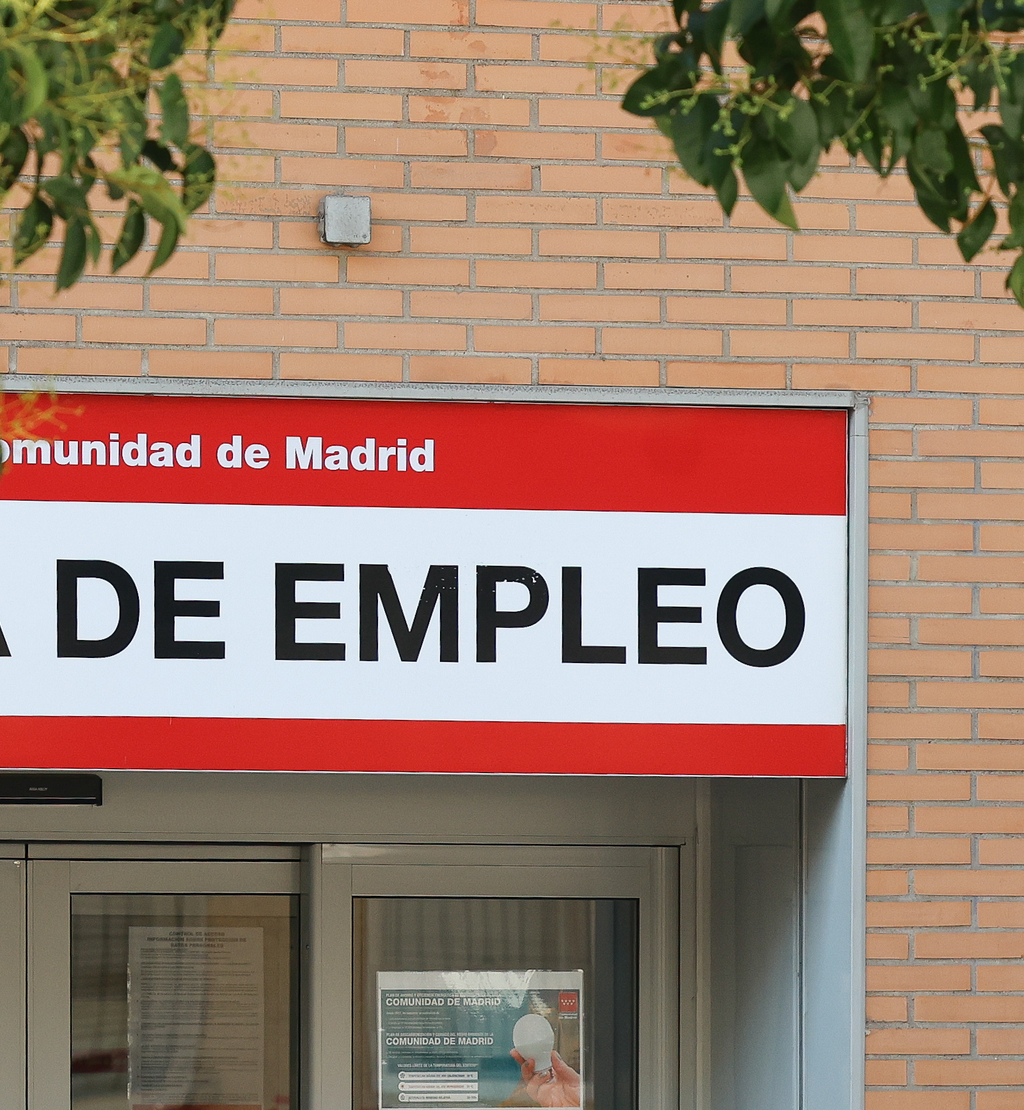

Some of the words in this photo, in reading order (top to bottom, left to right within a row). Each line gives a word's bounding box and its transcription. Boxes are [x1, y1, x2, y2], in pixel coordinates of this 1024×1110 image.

[216, 435, 269, 469] de
[285, 436, 435, 472] Madrid
[56, 558, 226, 660] DE
[274, 561, 807, 668] EMPLEO
[385, 998, 445, 1006] COMUNIDAD
[447, 998, 461, 1006] DE
[463, 997, 501, 1006] MADRID
[385, 1037, 441, 1046] COMUNIDAD
[443, 1037, 456, 1046] DE
[458, 1037, 494, 1046] MADRID
